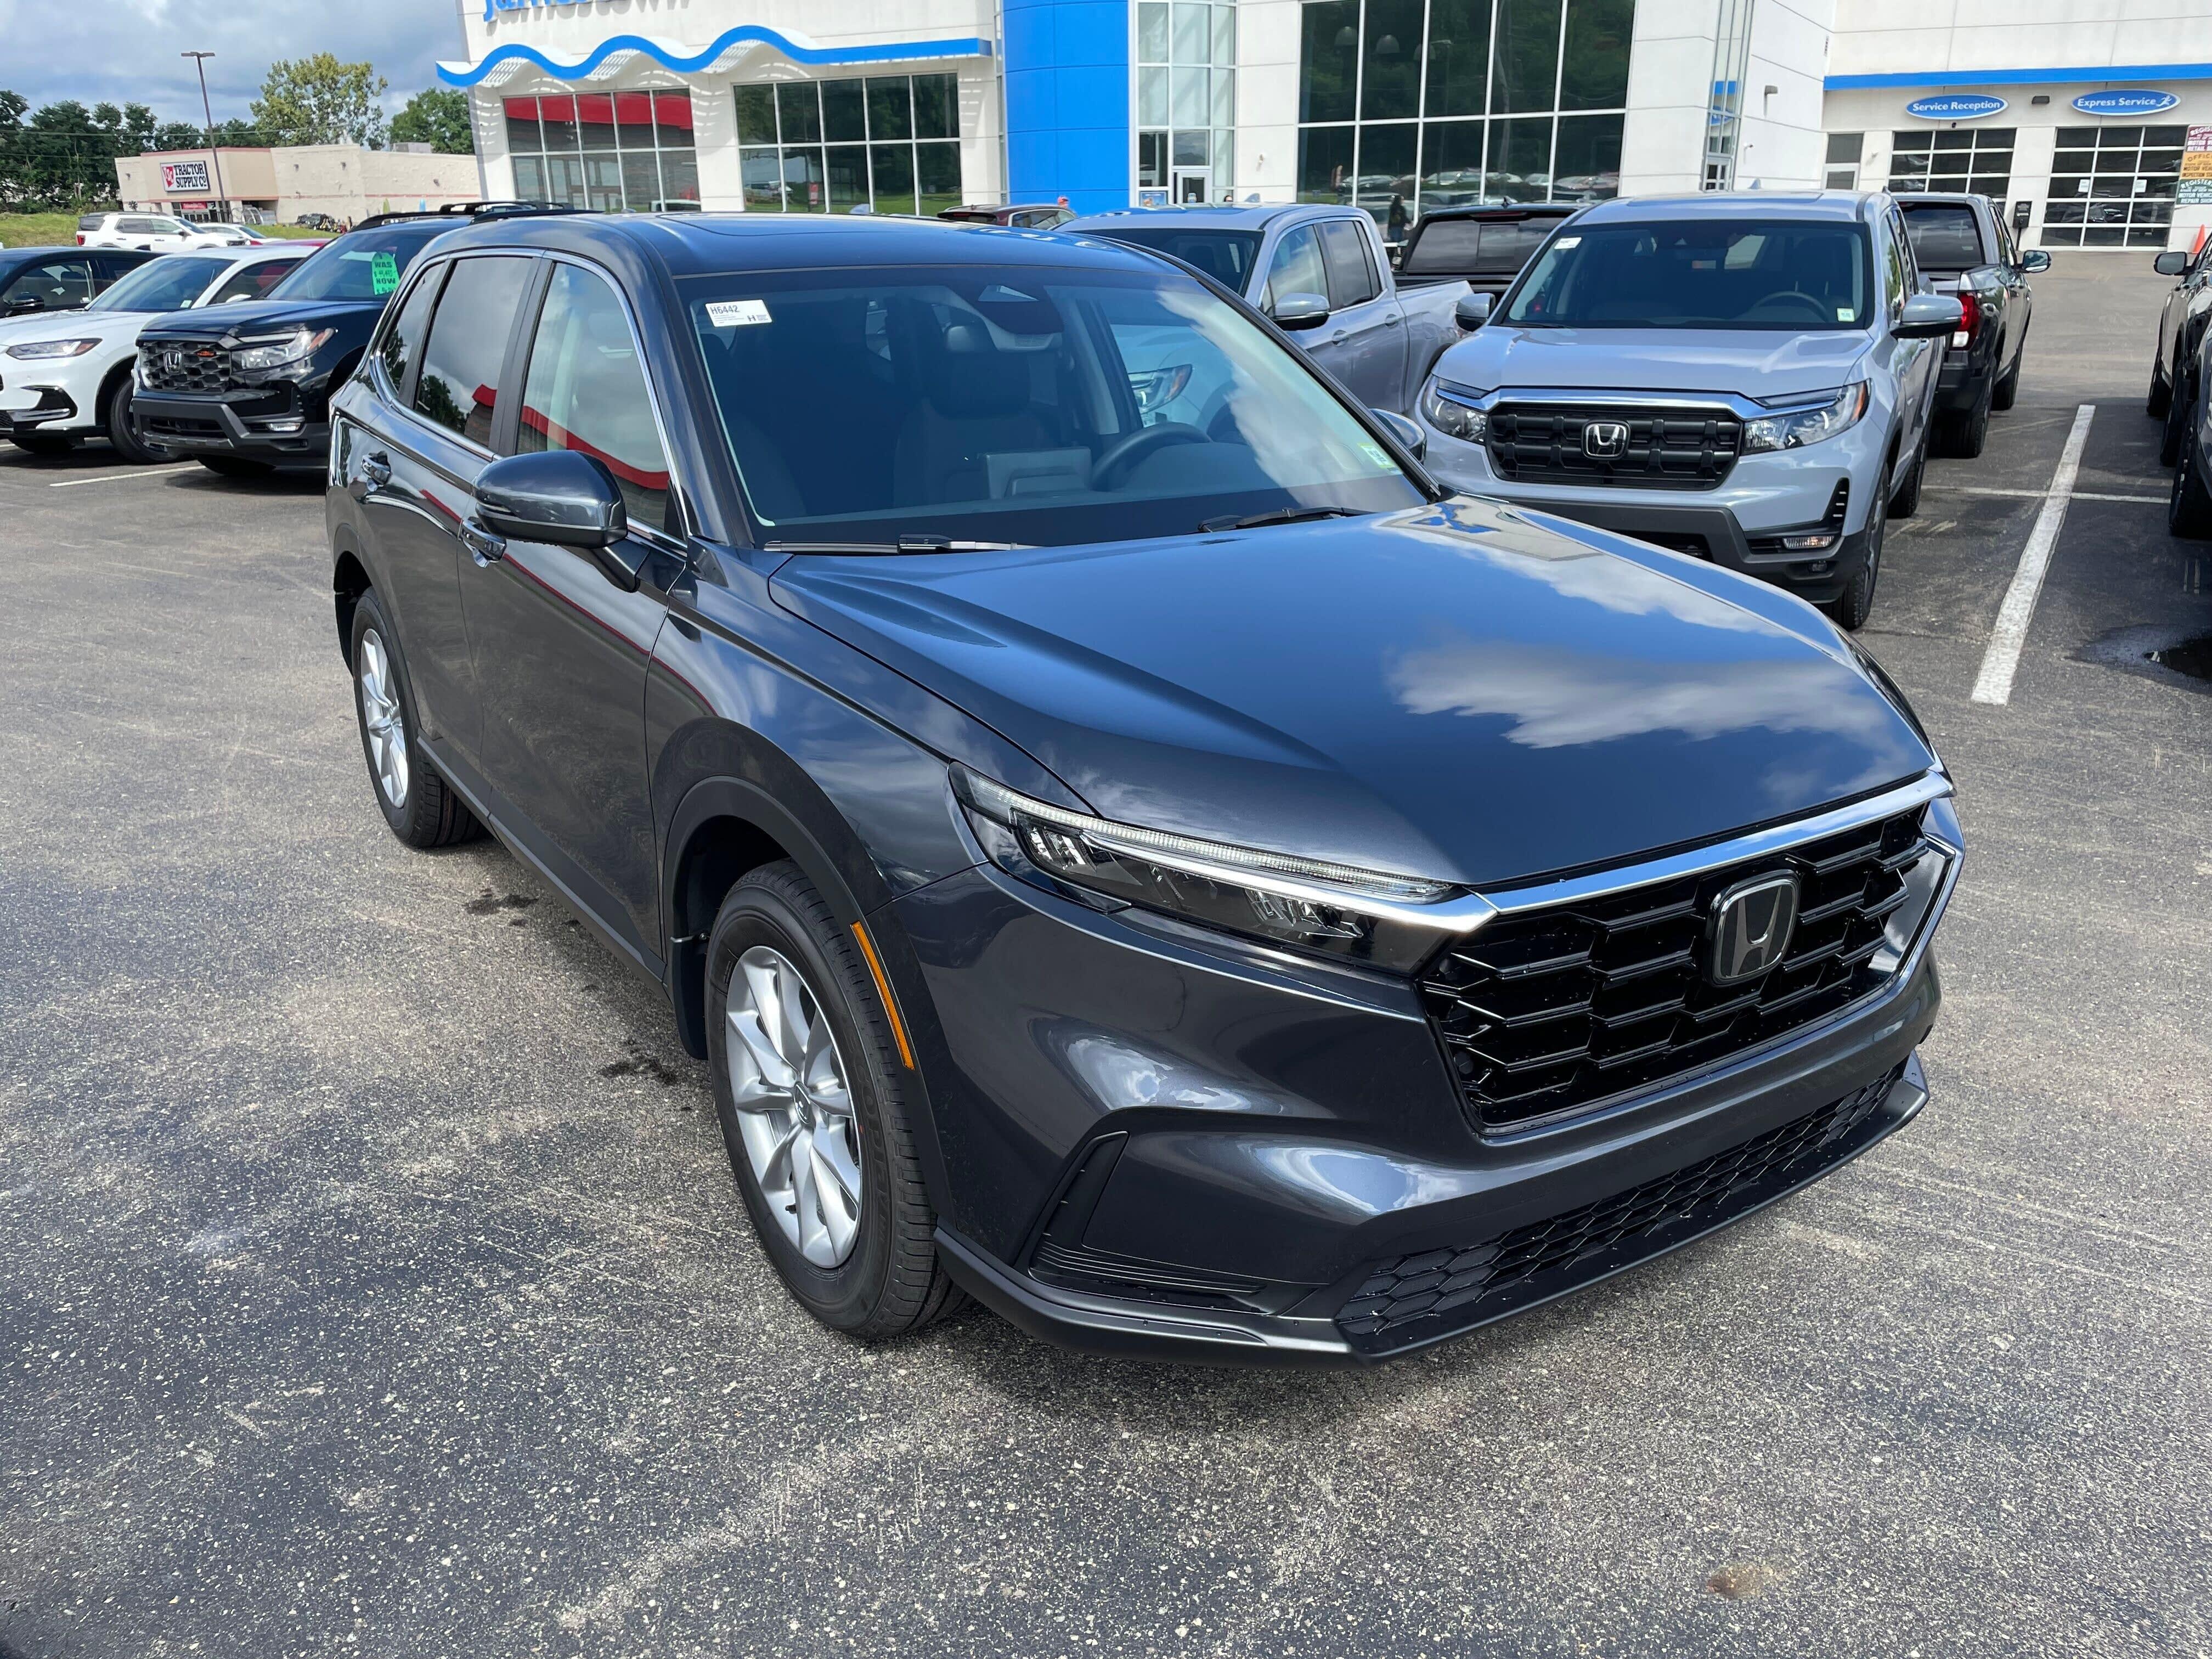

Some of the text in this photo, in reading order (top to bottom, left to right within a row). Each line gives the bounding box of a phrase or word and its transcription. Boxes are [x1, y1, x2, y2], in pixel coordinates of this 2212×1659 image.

[1912, 100, 2000, 111] Service Reception
[2077, 97, 2156, 109] Express Service
[2190, 127, 2212, 136] REGIS
[173, 163, 205, 176] TRACTOR
[176, 176, 199, 188] SUPPLY
[710, 305, 740, 314] H6442
